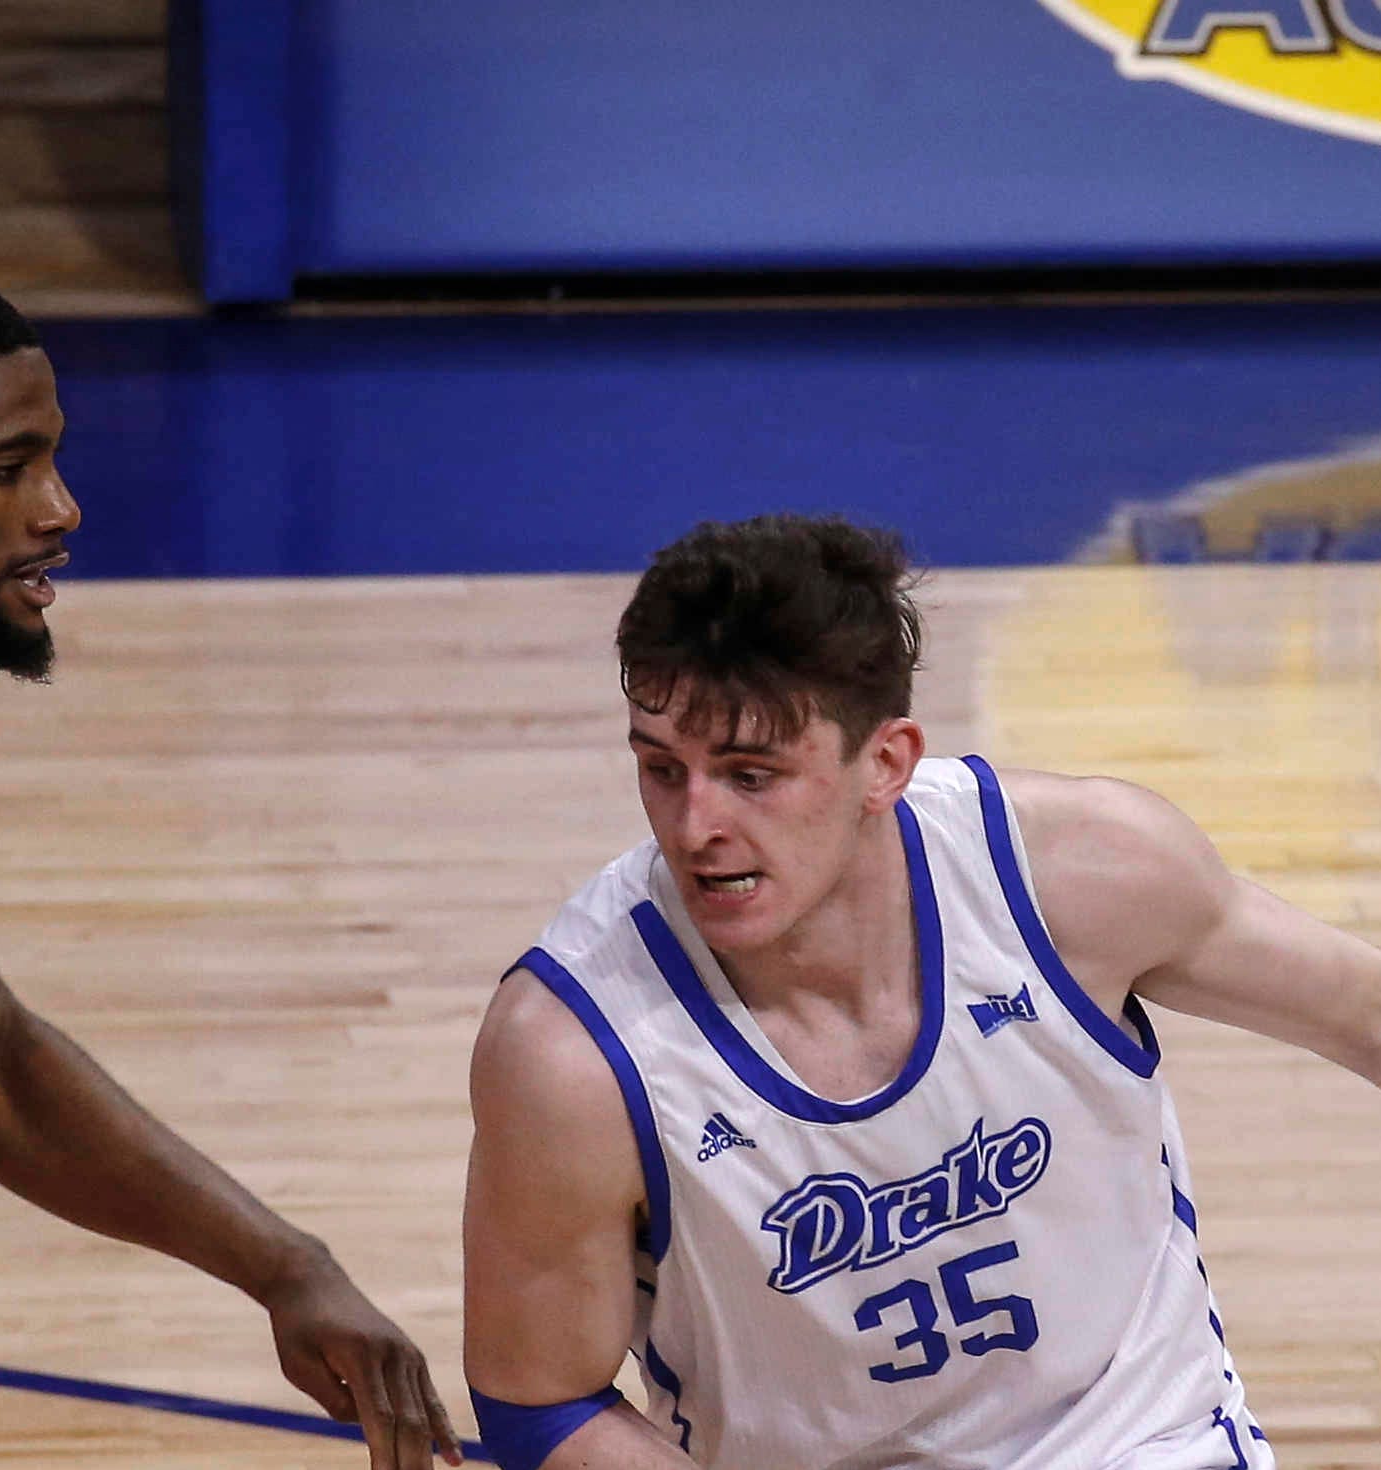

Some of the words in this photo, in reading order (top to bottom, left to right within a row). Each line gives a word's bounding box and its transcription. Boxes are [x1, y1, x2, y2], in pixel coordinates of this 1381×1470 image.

[697, 1133, 757, 1162] adidas
[760, 1116, 1052, 1295] Drake
[853, 1240, 1039, 1384] 35
